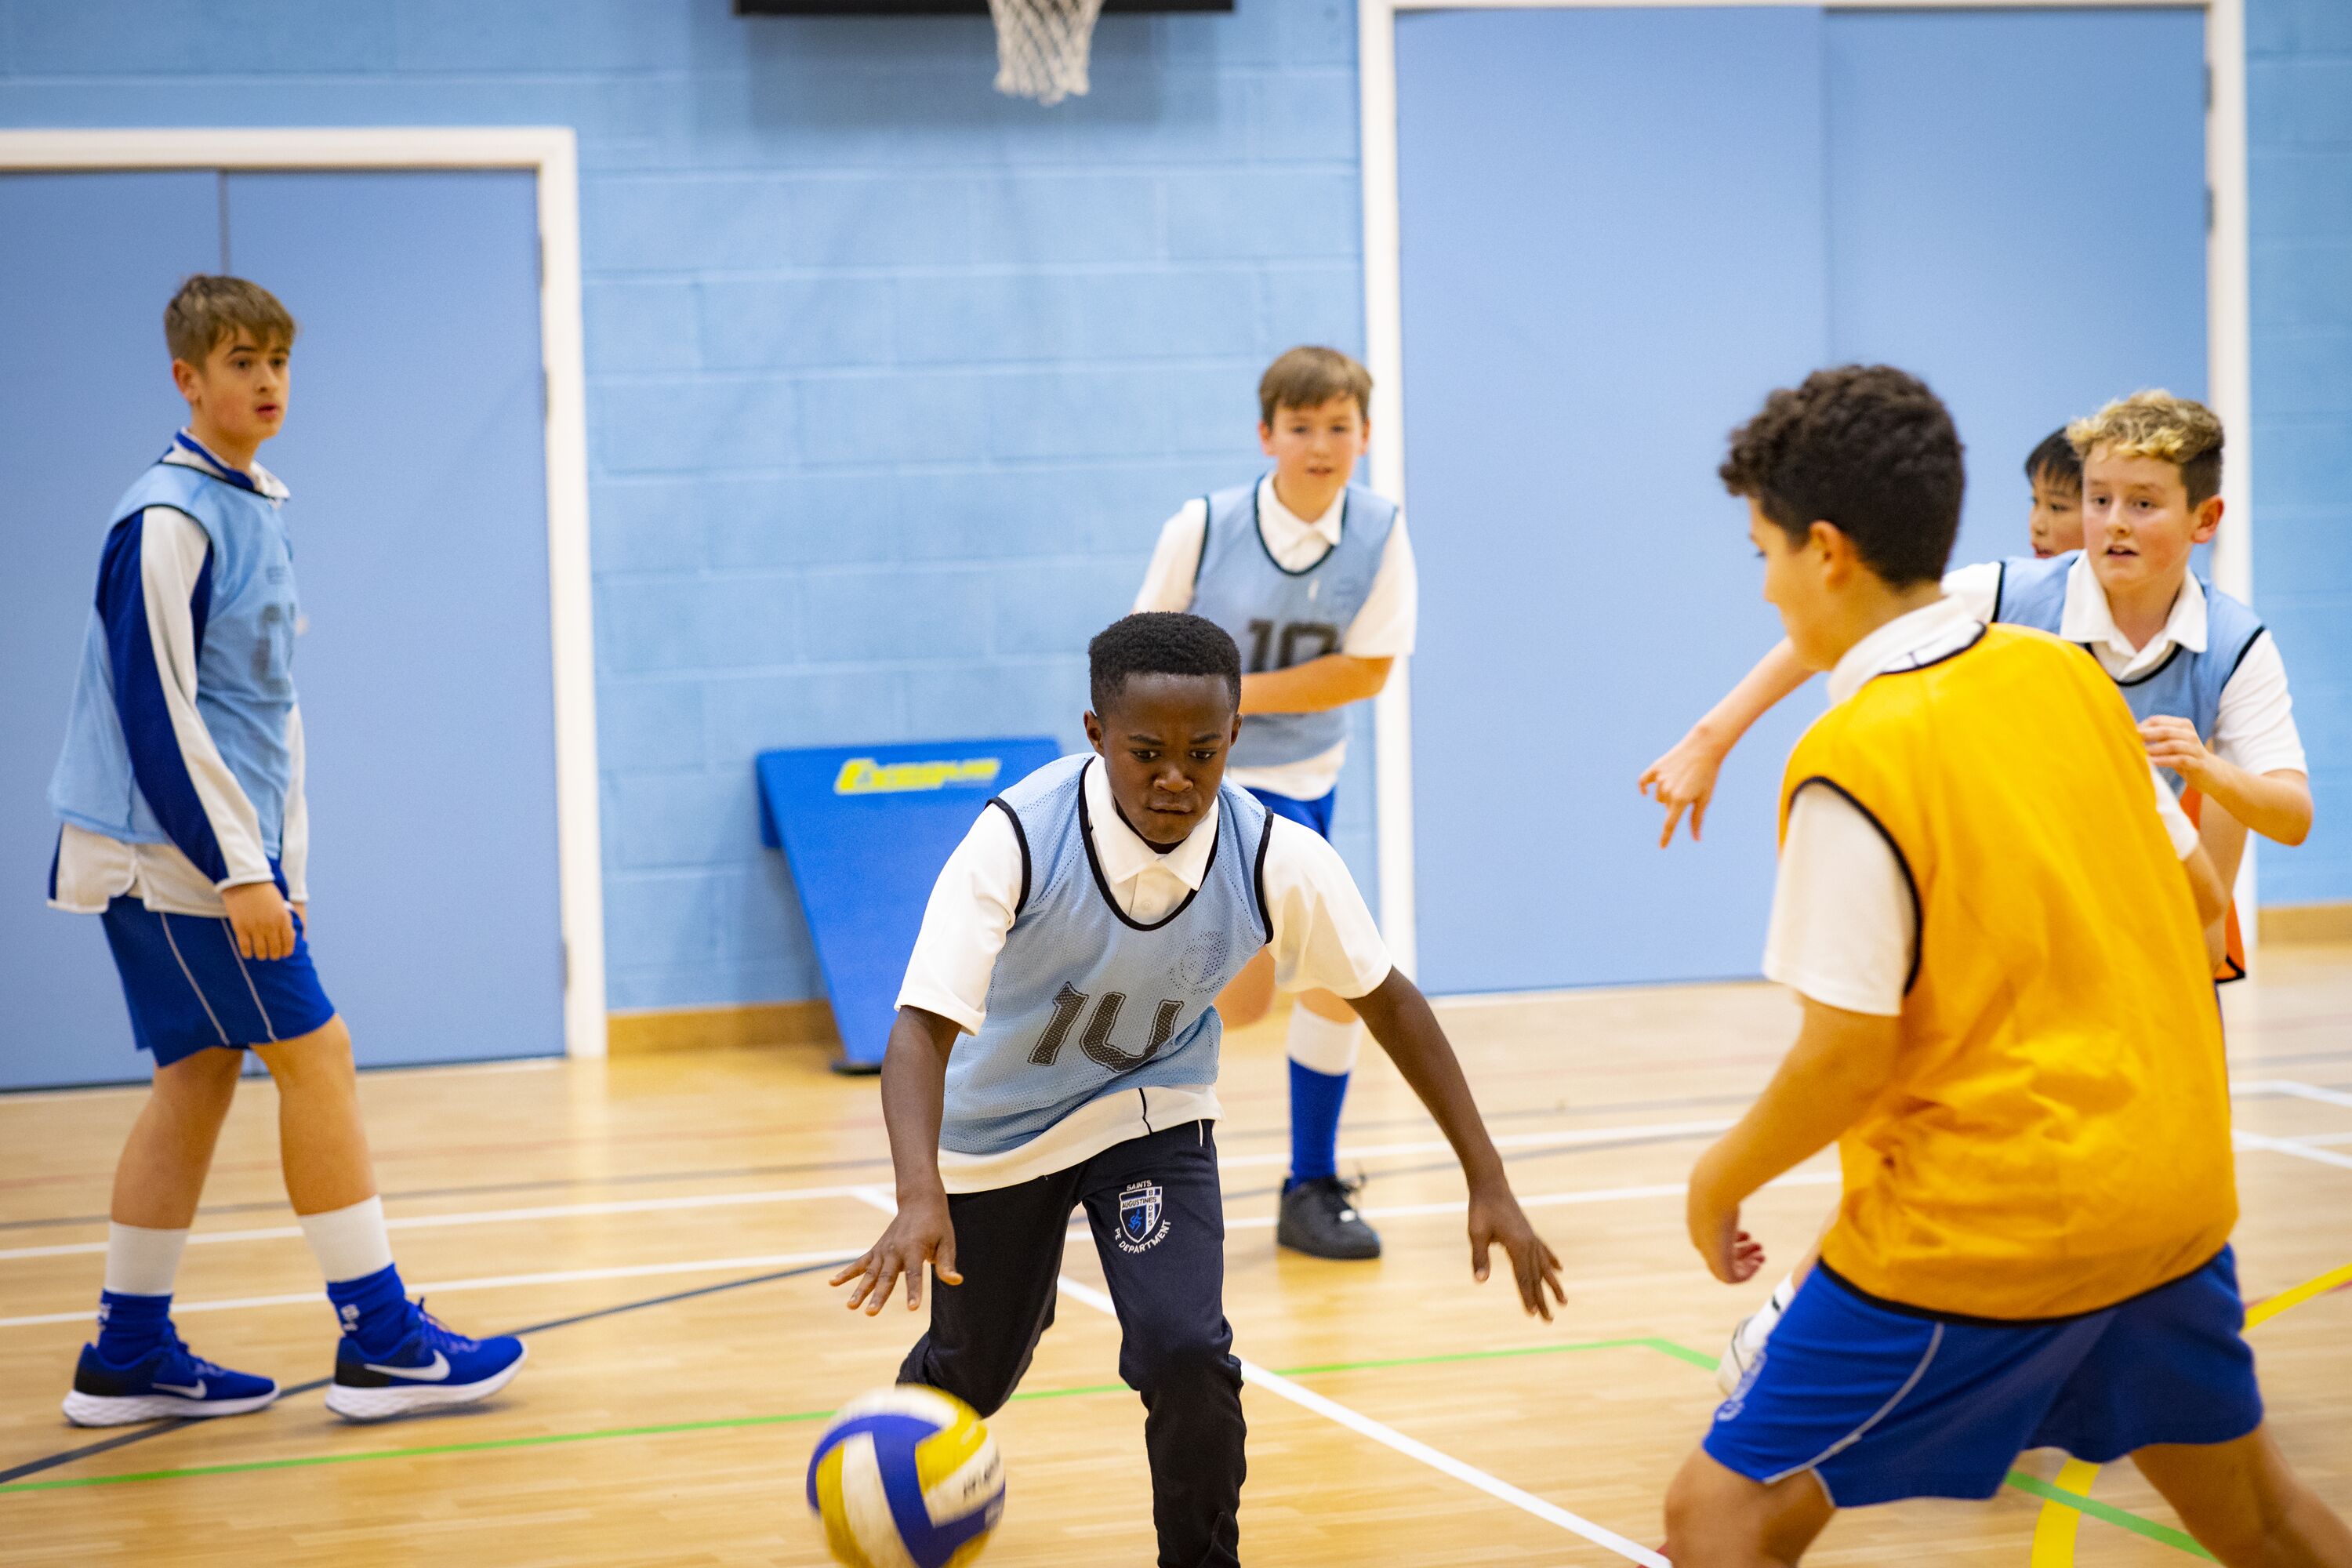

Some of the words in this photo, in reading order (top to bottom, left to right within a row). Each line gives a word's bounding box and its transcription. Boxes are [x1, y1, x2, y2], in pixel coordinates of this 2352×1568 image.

[1127, 1180, 1152, 1191] SAINTS
[1122, 1196, 1157, 1208] AUGUSTINES
[1115, 1227, 1121, 1240] PE
[1119, 1219, 1171, 1254] DEPARTMENT
